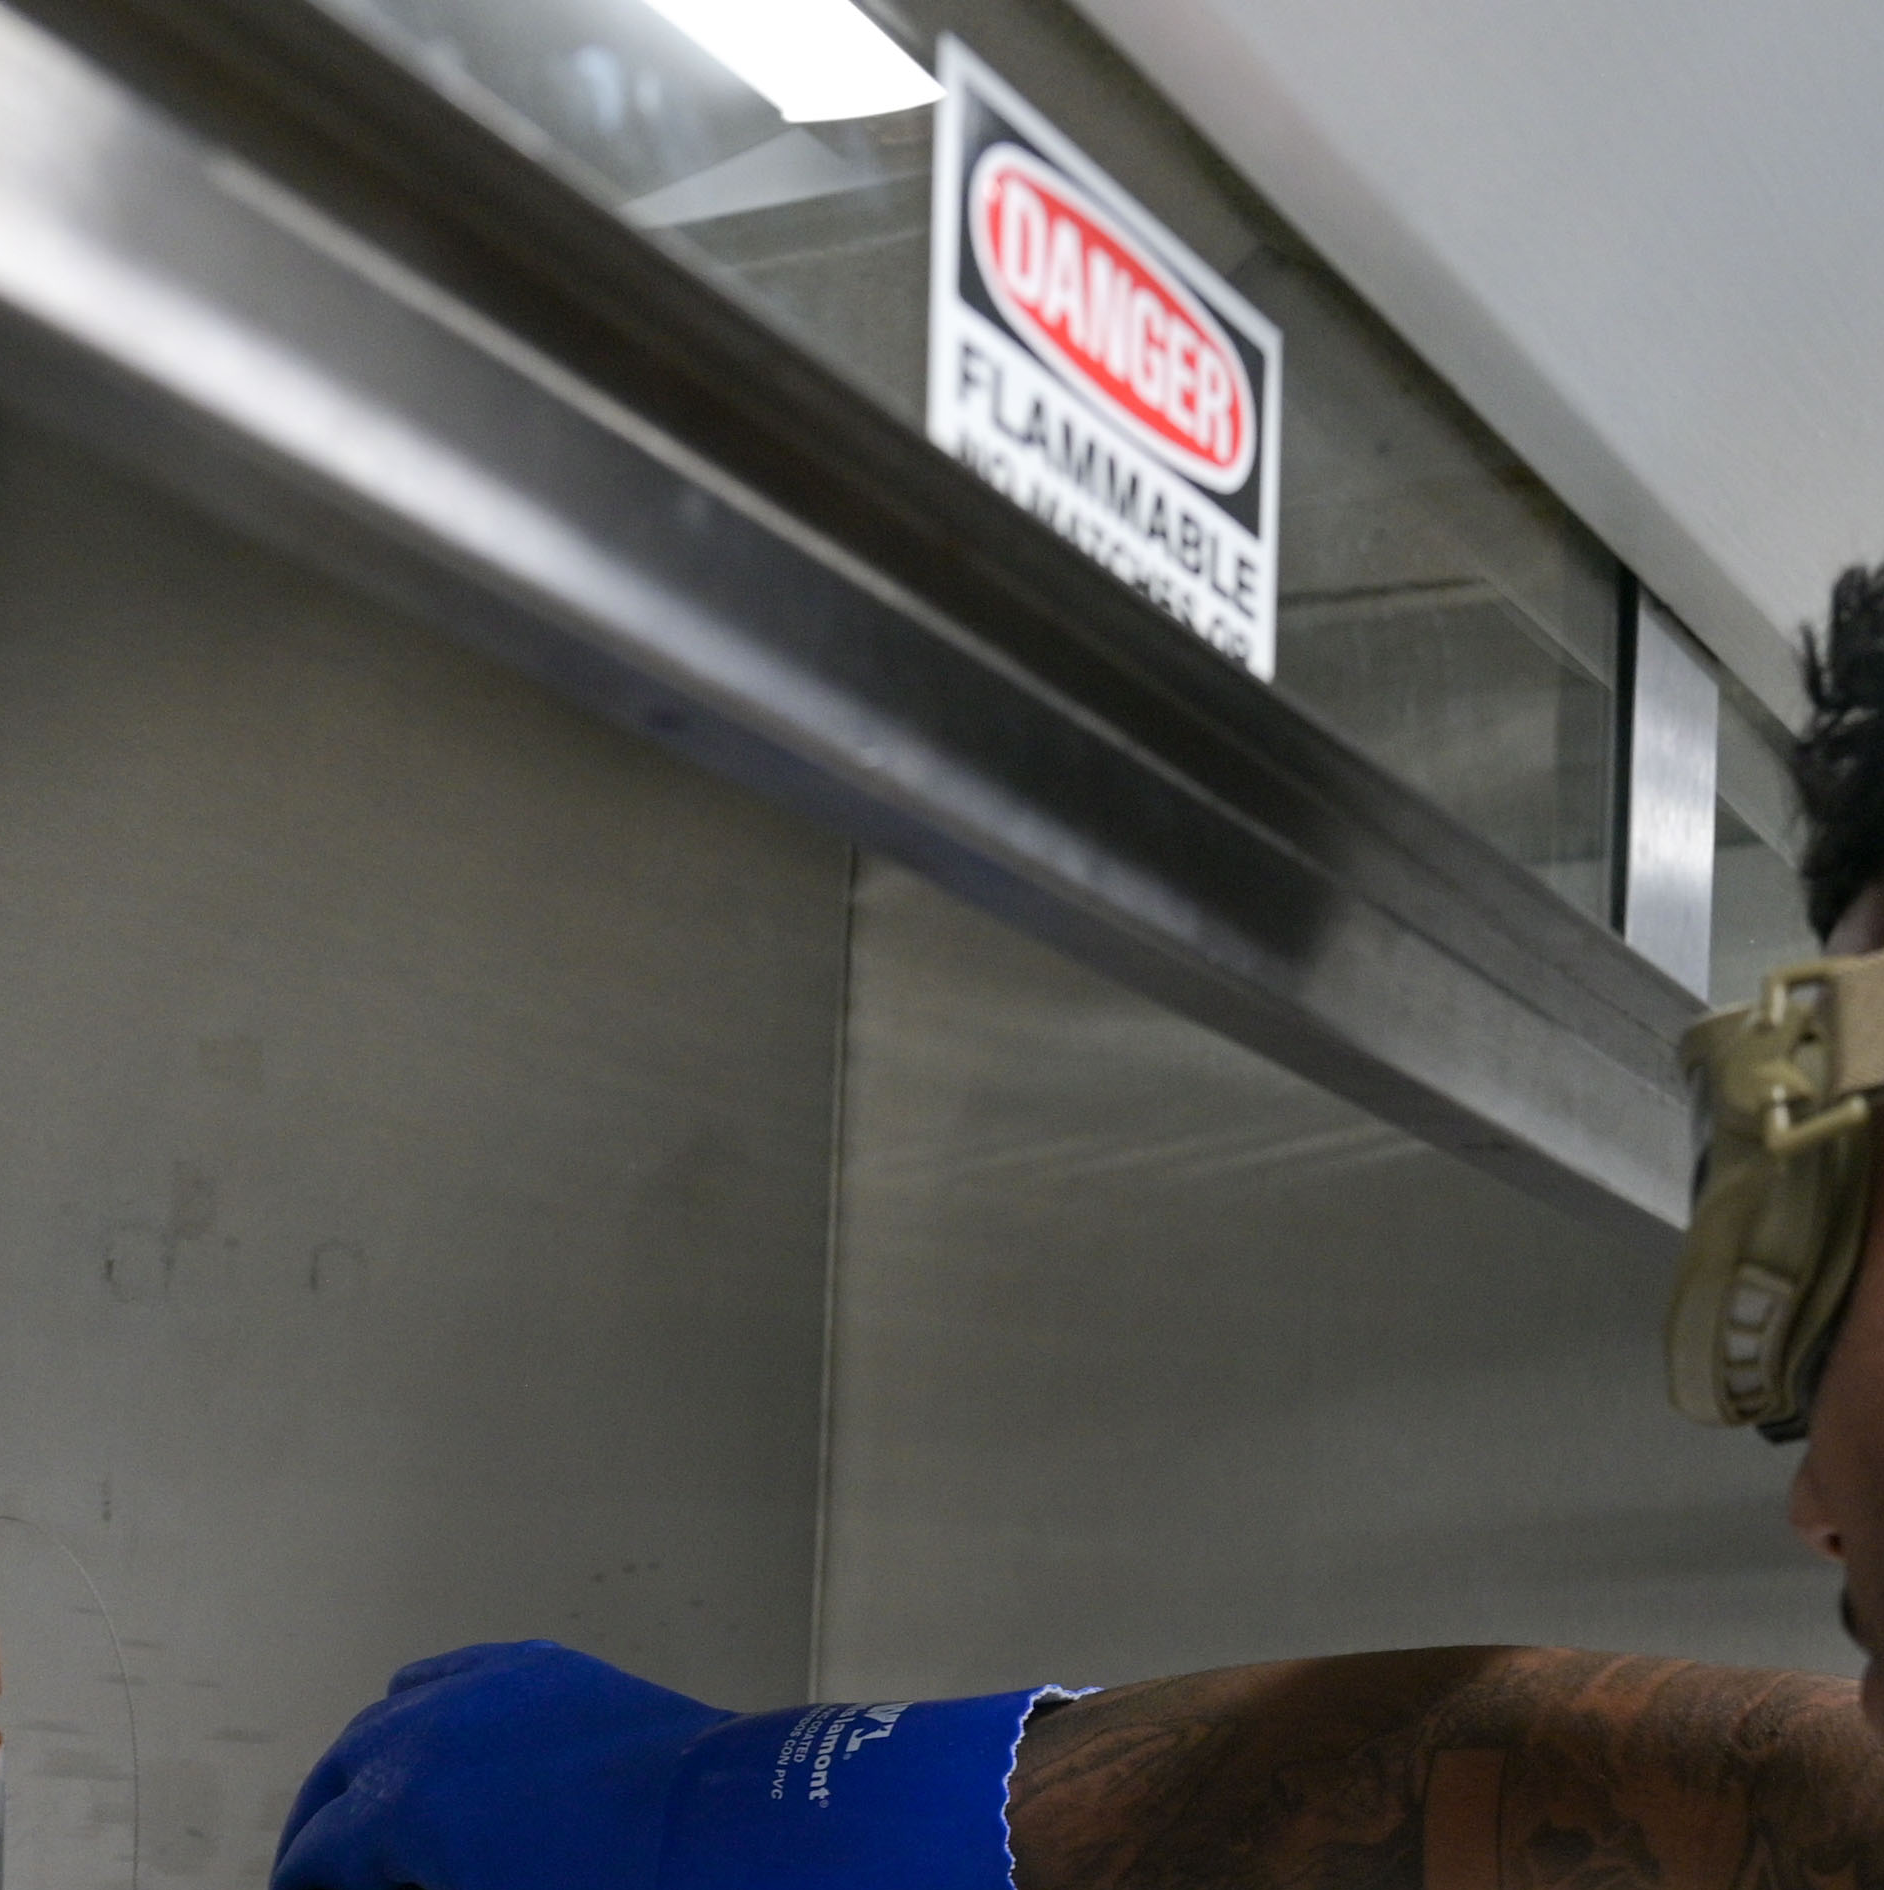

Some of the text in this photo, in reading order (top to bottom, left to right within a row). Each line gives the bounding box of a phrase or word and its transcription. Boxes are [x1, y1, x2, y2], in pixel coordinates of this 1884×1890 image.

[1000, 172, 1234, 469] DANGER
[959, 343, 1257, 623] FLAMMABLE
[770, 1768, 787, 1801] PVC
[776, 1738, 797, 1766] CON
